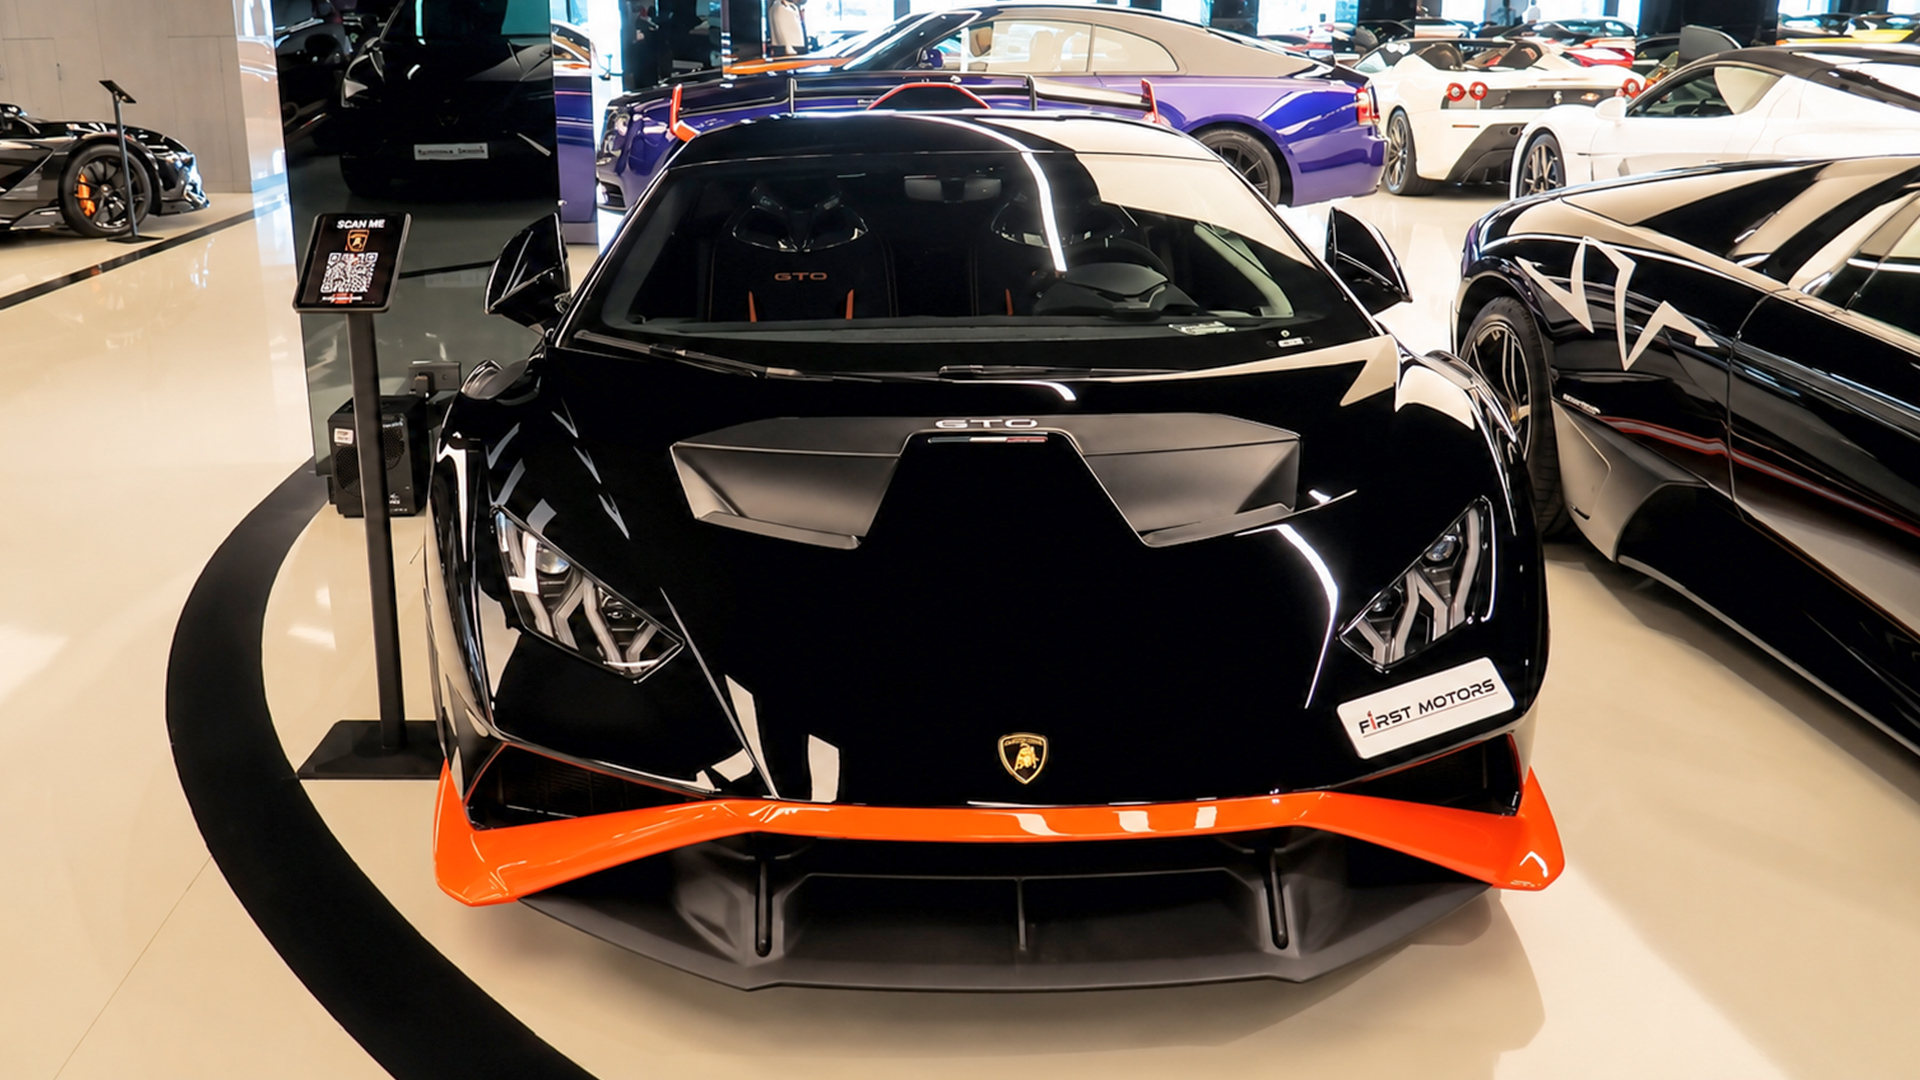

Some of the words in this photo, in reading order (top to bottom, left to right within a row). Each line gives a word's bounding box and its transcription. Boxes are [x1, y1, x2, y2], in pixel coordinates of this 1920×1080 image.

[337, 219, 367, 229] SCAN
[368, 219, 386, 229] ME
[774, 272, 828, 281] GTO
[935, 419, 1038, 429] GTO
[1418, 678, 1496, 715] MOTORS
